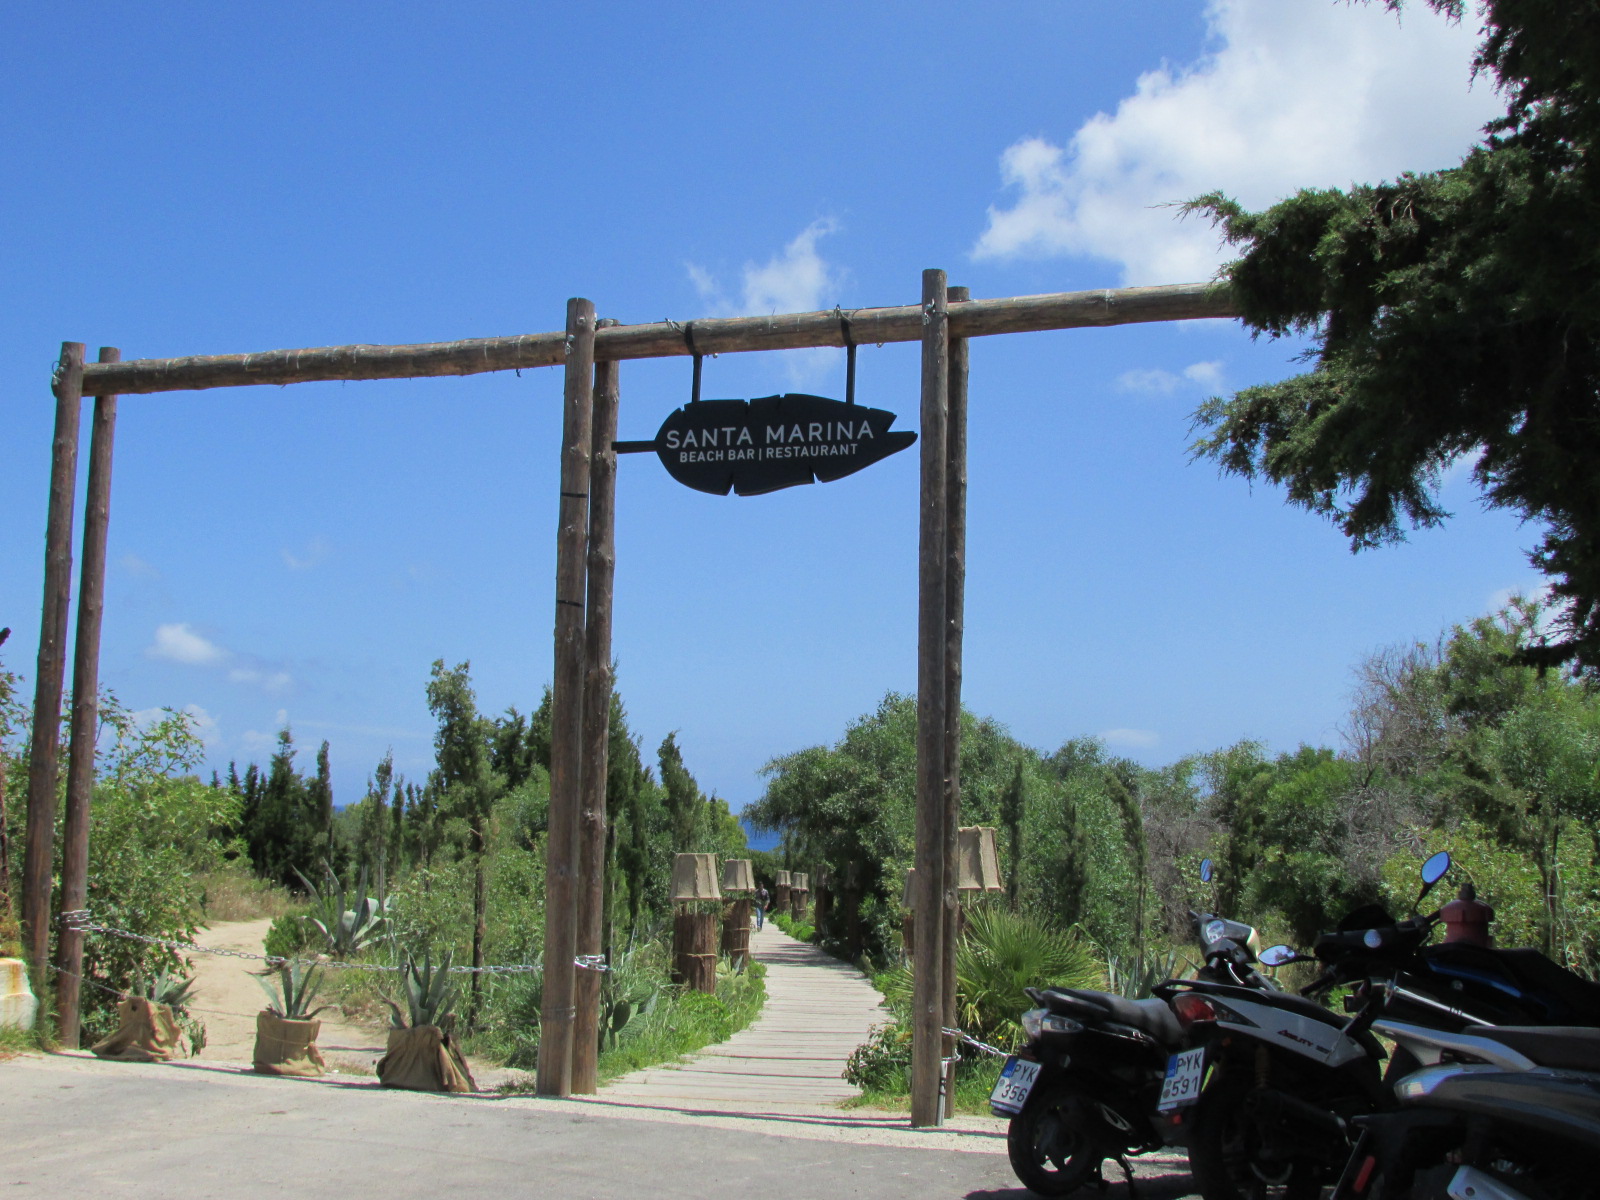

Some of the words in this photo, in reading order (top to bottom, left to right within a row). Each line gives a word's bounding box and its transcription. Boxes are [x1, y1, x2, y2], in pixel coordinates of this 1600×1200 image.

[666, 426, 753, 449] SANTA
[766, 420, 874, 444] MARINA
[680, 450, 724, 463] BEACH
[728, 448, 755, 461] BAR
[766, 443, 858, 458] RESTAURANT
[1011, 1063, 1039, 1083] PYK
[1175, 1052, 1202, 1075] PYK
[1001, 1083, 1028, 1102] 356
[1171, 1075, 1198, 1097] 591
